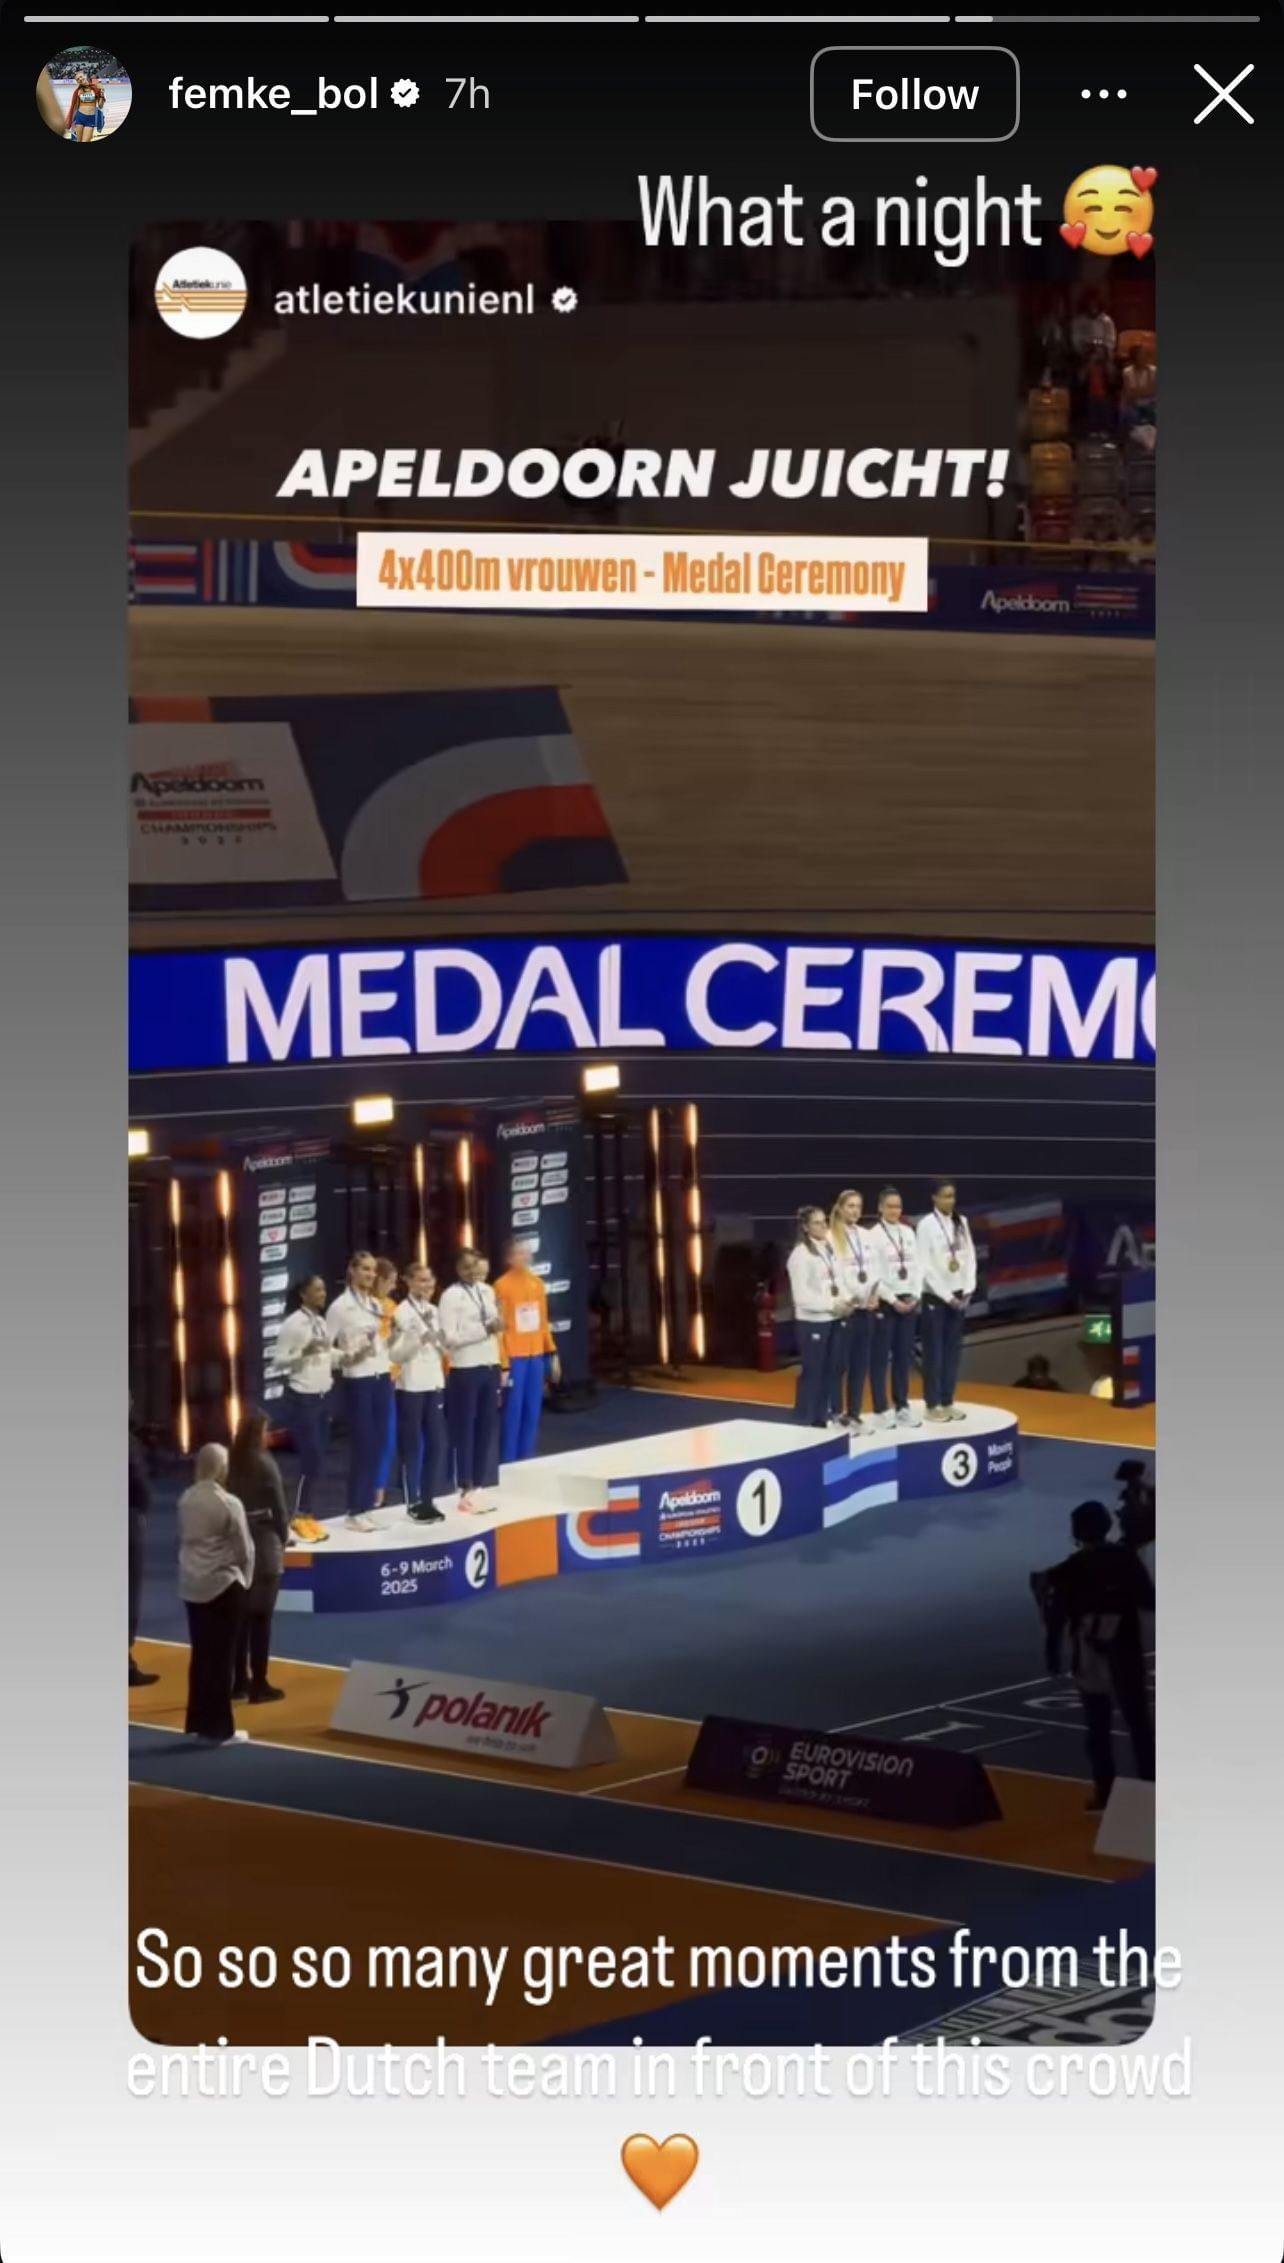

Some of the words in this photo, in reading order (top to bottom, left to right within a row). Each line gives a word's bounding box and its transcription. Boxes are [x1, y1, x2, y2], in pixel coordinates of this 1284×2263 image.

[226, 944, 667, 1061] MEDAL
[685, 942, 1156, 1060] CEREM
[953, 1449, 970, 1480] 3
[752, 1479, 766, 1526] 1
[411, 1556, 453, 1574] March
[473, 1548, 487, 1583] 2
[381, 1579, 418, 1596] 2025
[413, 1691, 551, 1738] polanik
[783, 1762, 851, 1789] SPORT
[790, 1741, 914, 1778] EUROVISION
